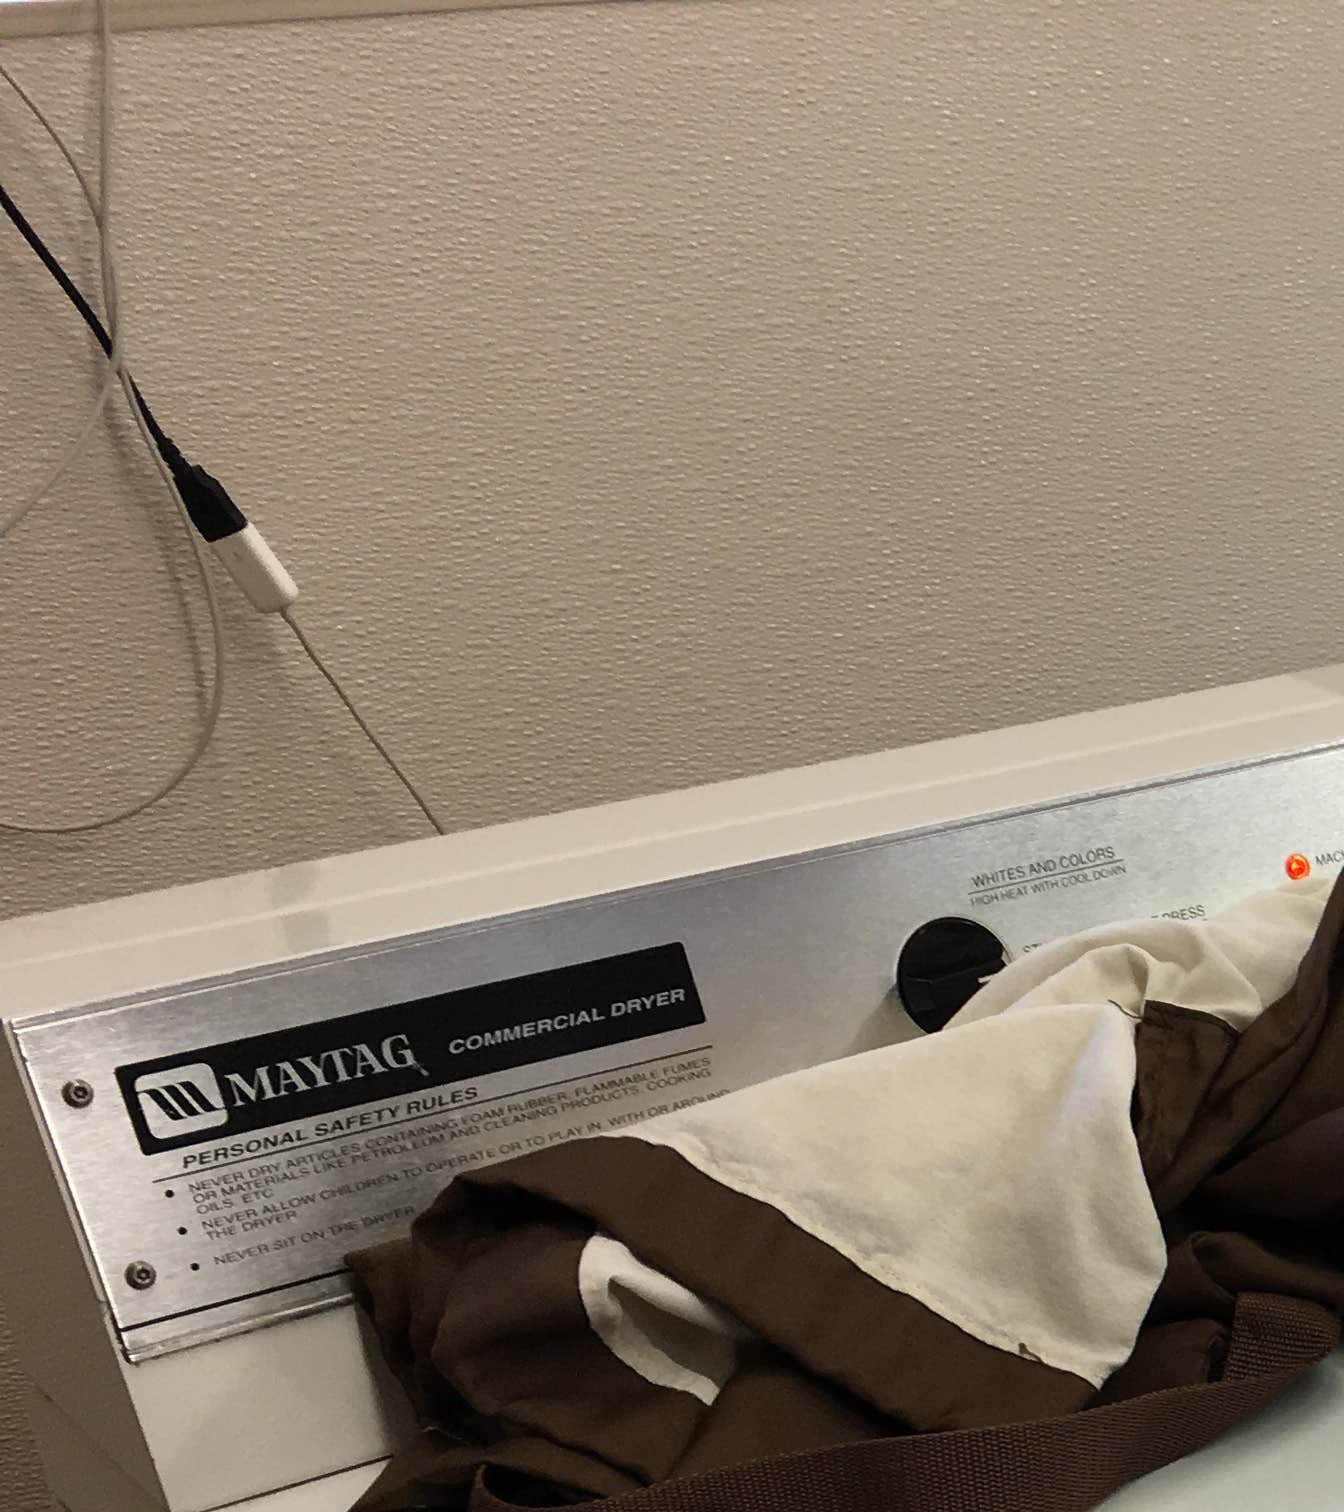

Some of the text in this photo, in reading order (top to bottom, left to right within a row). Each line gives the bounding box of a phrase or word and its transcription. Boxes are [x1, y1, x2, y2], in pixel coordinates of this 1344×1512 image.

[969, 893, 999, 907] HIGH
[1001, 884, 1029, 900] HEAT
[1031, 877, 1060, 894] WITH
[1061, 871, 1093, 888] COOL
[971, 846, 1116, 888] WHITES AND COLORS
[223, 988, 686, 1108] MAYTAG COMMERCIAL DRYER
[182, 1087, 479, 1169] PERSONAL SAFETY RULES
[188, 1171, 245, 1193] NEVER
[247, 1162, 281, 1179] DRY
[286, 1142, 361, 1168] ARTICLES
[364, 1119, 459, 1150] CONTAINING
[461, 1107, 504, 1126] FOAM
[574, 1069, 658, 1096] FLAMMABLE
[662, 1057, 712, 1076] FUMES
[193, 1190, 218, 1204] OR
[220, 1166, 311, 1197] MATERIALS
[312, 1158, 347, 1174] LIKE
[351, 1132, 445, 1163] PETROLEUM
[449, 1125, 481, 1141] AND
[483, 1105, 558, 1132] CLEANING
[646, 1068, 712, 1092] COOKING
[201, 1208, 258, 1229] NEVER
[262, 1193, 317, 1214] ALLOW
[319, 1174, 400, 1201] CHILDREN
[402, 1166, 422, 1179] TO
[425, 1148, 497, 1174] OPERATE
[499, 1141, 523, 1155] OR
[525, 1134, 546, 1148] TO
[547, 1122, 582, 1141] PLAY
[607, 1110, 645, 1127] WITH
[647, 1104, 670, 1118] OR
[206, 1210, 298, 1241] THE DRYER
[213, 1243, 270, 1266] NEVER
[272, 1235, 298, 1255] SIT
[300, 1229, 326, 1245] ON
